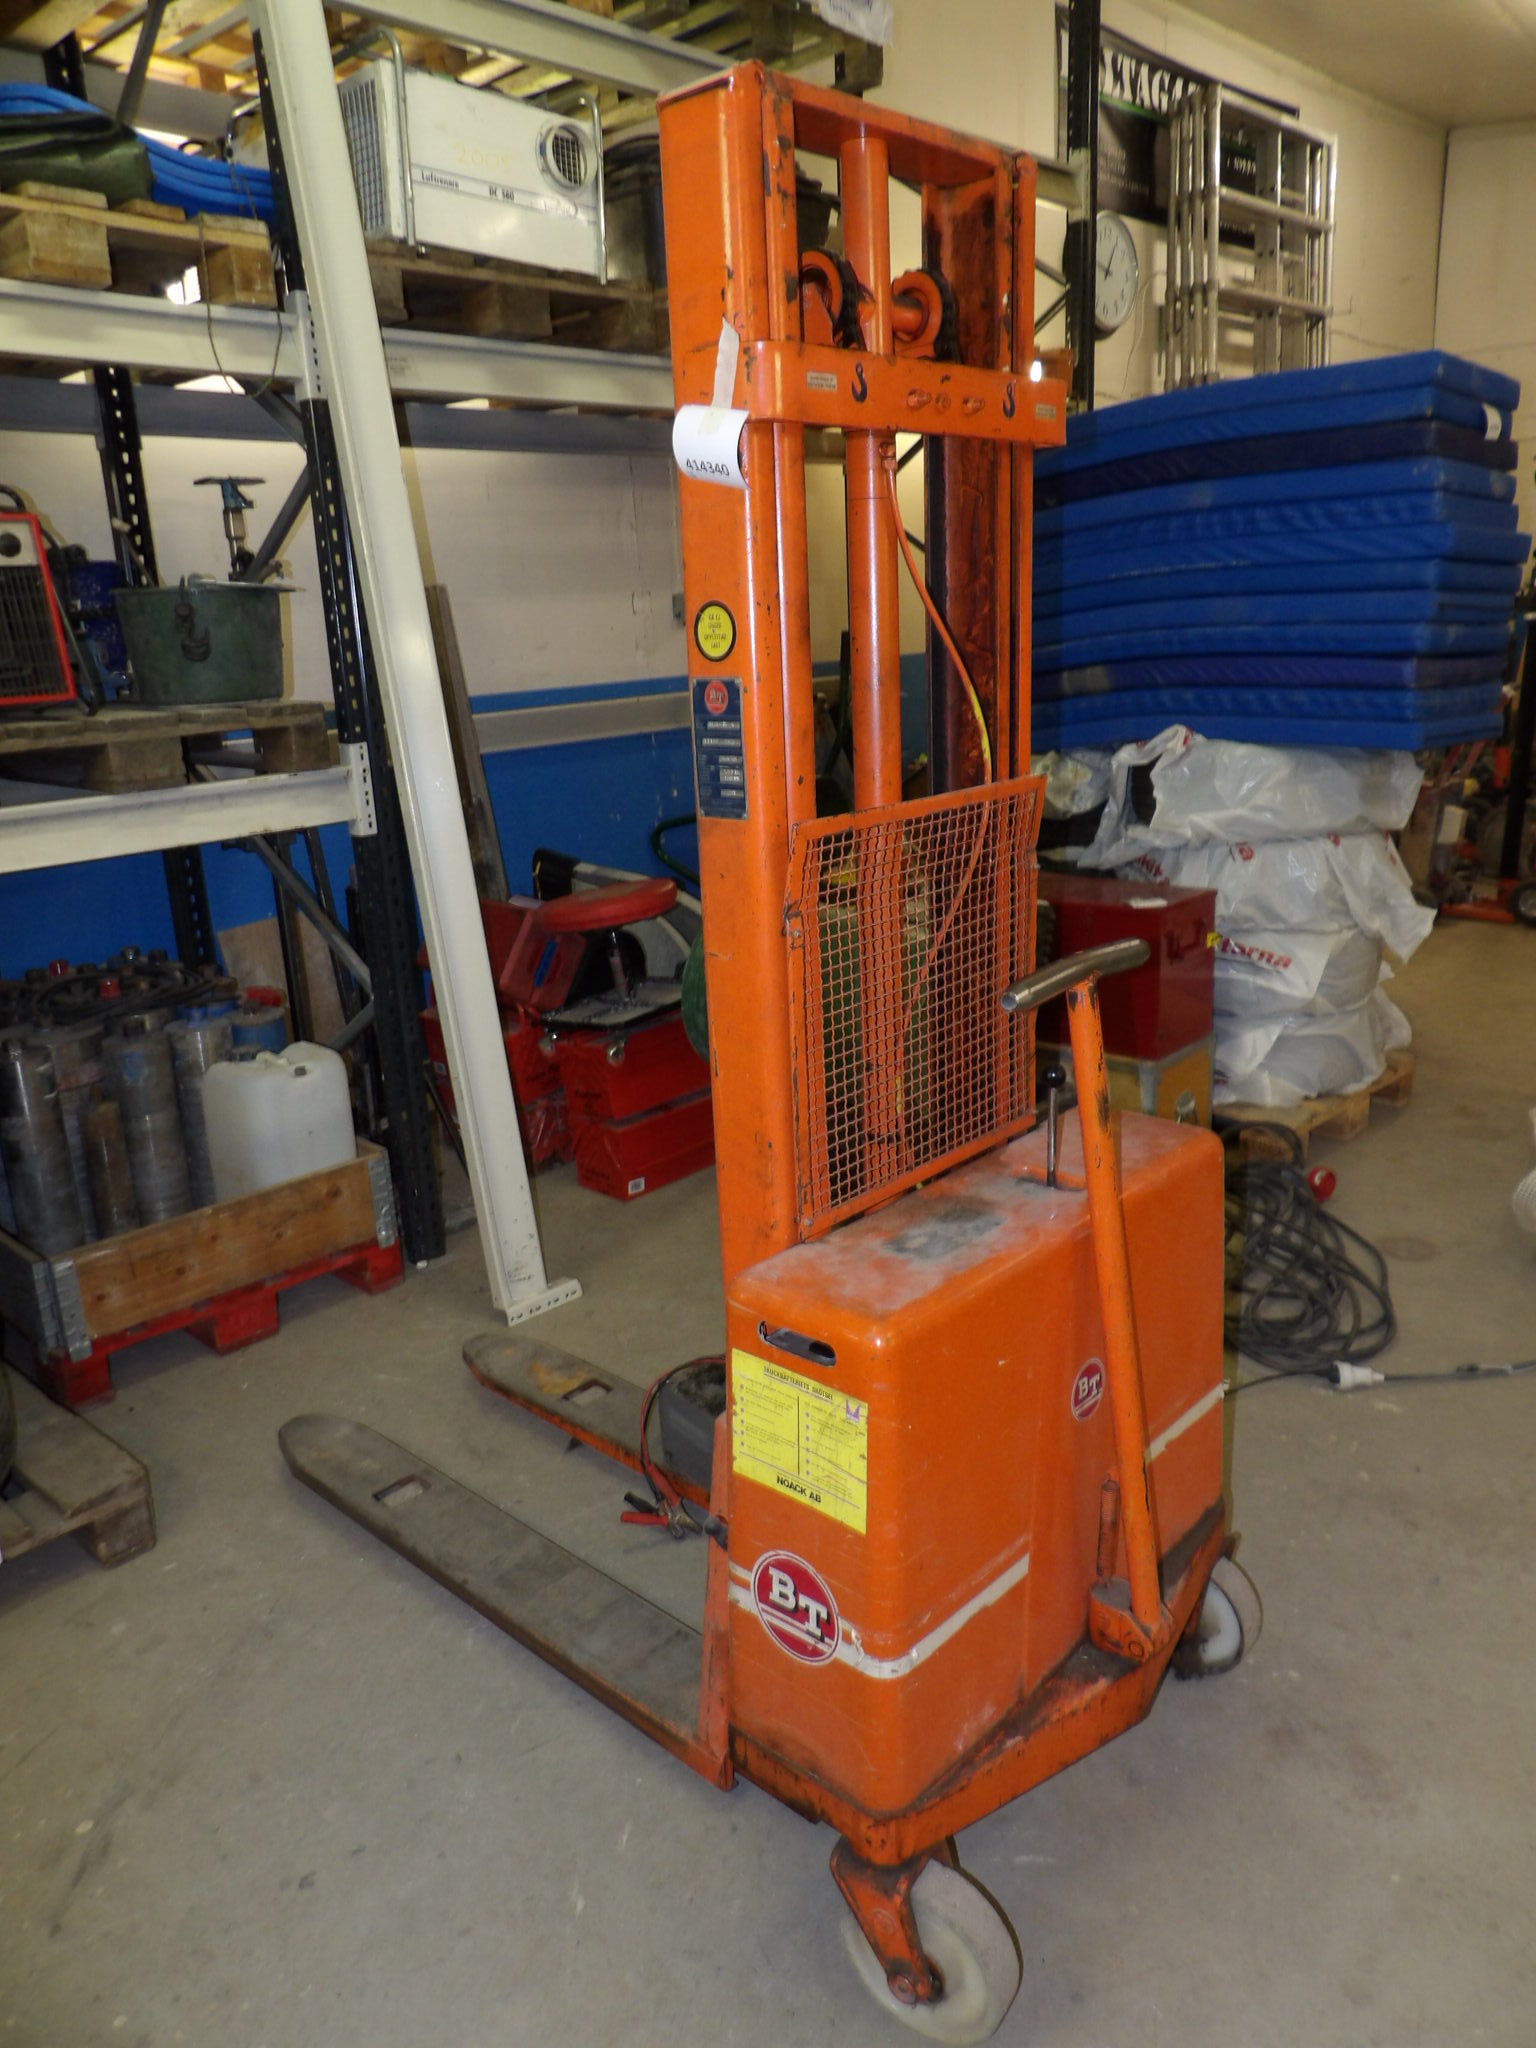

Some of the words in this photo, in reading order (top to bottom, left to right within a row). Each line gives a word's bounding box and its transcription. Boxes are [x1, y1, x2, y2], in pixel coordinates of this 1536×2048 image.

[685, 458, 730, 477] 414340
[1078, 1372, 1102, 1400] BT
[776, 1475, 808, 1497] NOACK
[808, 1490, 822, 1504] AB
[768, 1565, 830, 1641] BT
